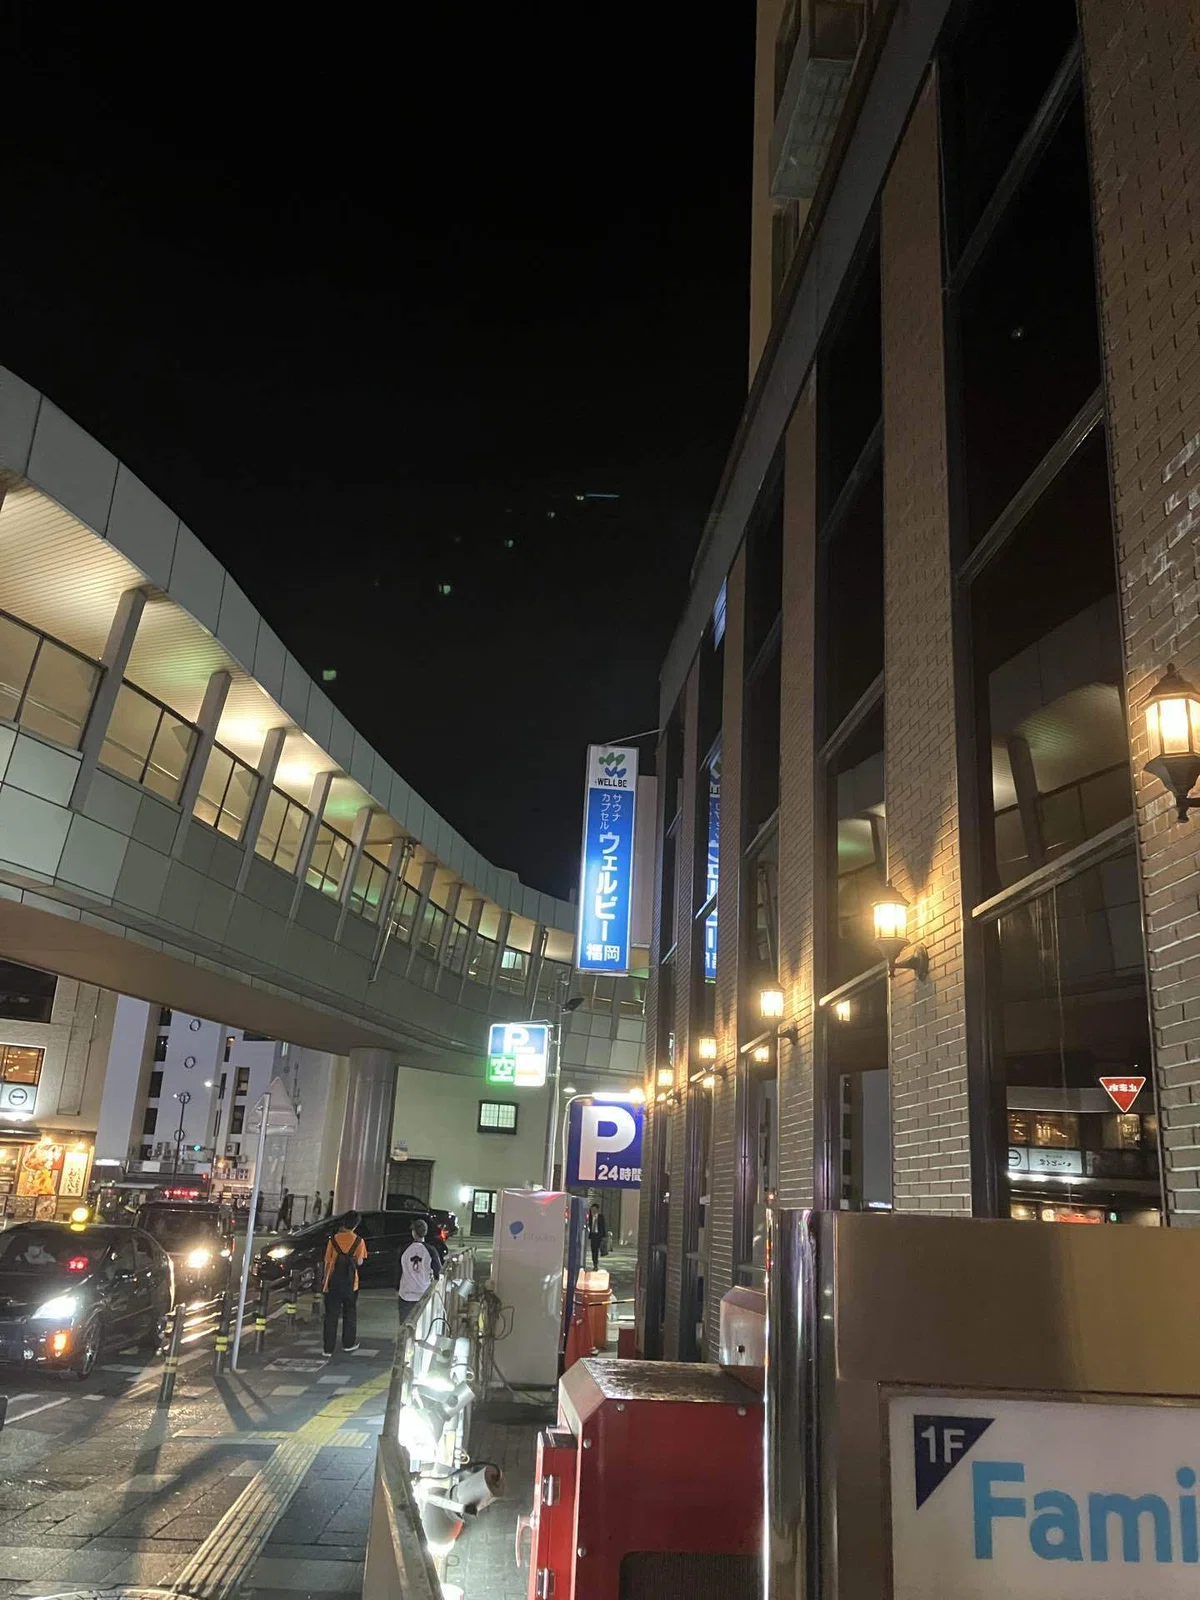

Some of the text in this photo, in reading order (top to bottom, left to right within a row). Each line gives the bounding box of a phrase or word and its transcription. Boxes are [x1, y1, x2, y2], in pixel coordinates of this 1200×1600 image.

[597, 777, 628, 788] WELLBE
[599, 793, 612, 830] カプセル
[612, 793, 623, 822] サウナ
[594, 831, 621, 942] ウェルビー
[586, 943, 621, 963] 福岡
[503, 1026, 531, 1055] P
[578, 1105, 636, 1181] P
[597, 1163, 643, 1182] 24時間
[920, 1424, 966, 1464] 1F
[971, 1460, 1200, 1564] Fami
